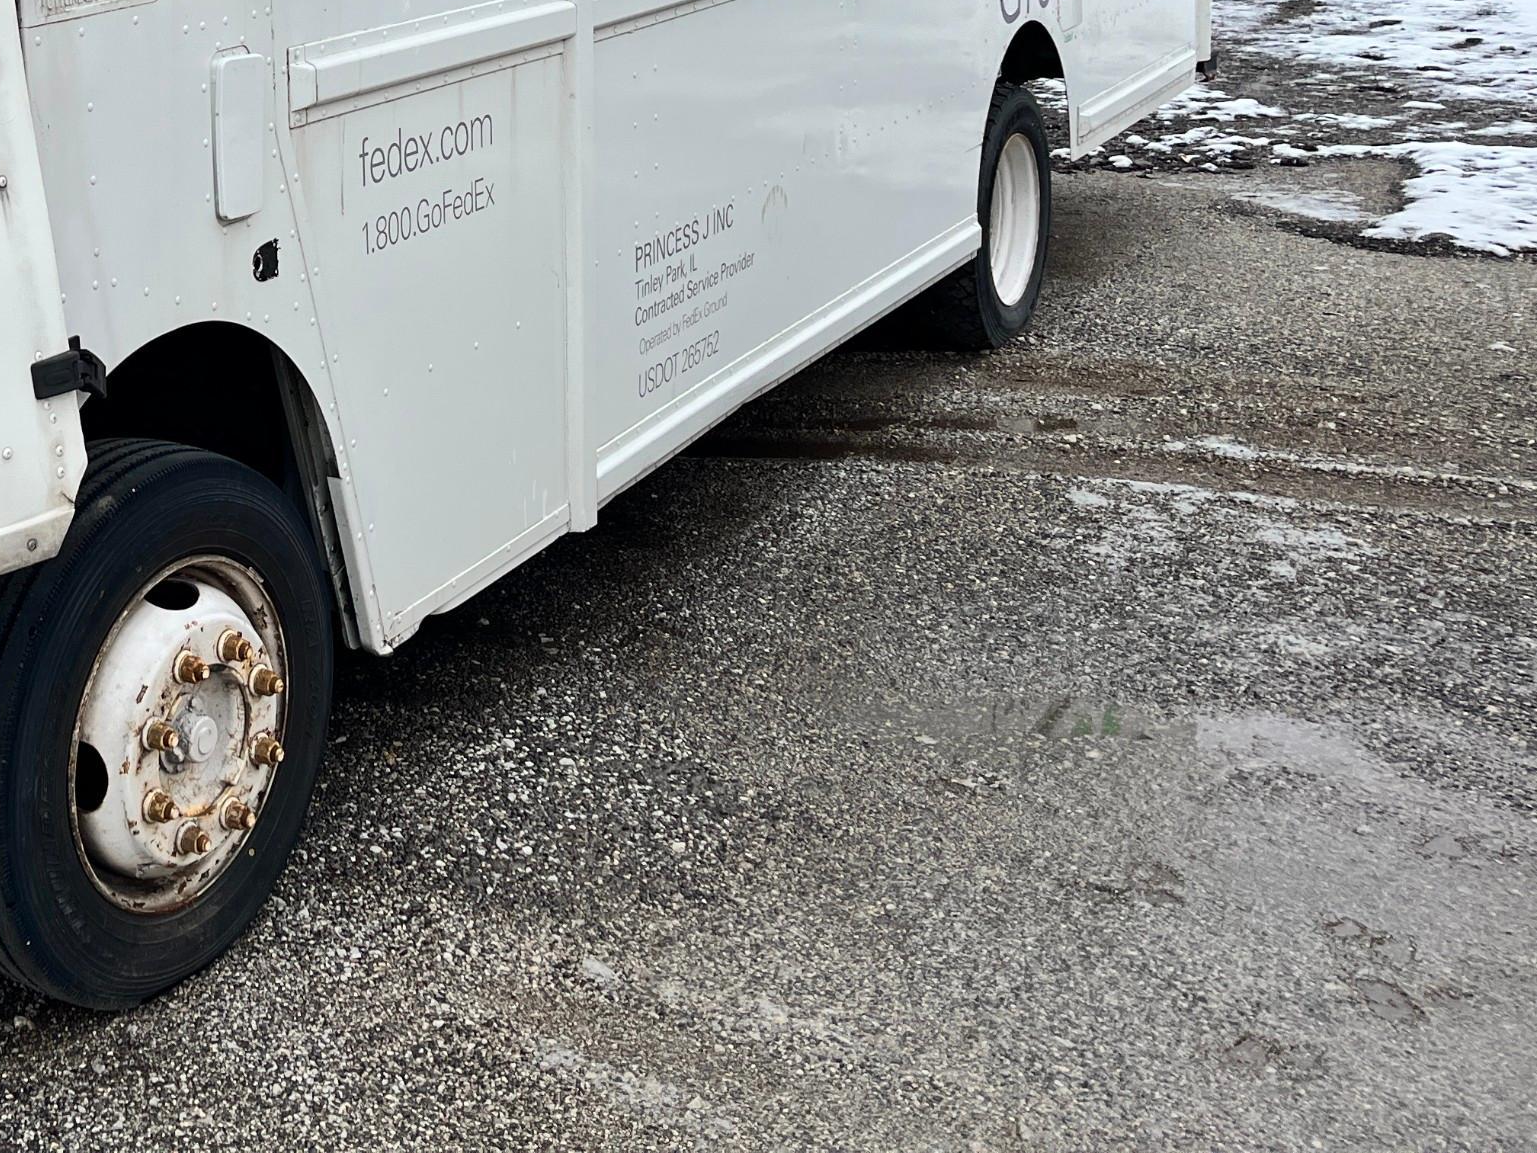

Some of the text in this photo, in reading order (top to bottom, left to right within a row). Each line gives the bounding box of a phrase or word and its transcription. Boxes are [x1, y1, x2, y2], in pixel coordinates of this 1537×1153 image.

[359, 114, 493, 187] fedex.com
[362, 177, 495, 255] 1.800.GoFedEx
[635, 203, 734, 273] PRINCESS J INC
[635, 253, 698, 301] Tinley Park, IL
[635, 251, 756, 327] Contracted Service Provider
[639, 292, 728, 356] Operated by FedEx Ground
[638, 330, 720, 398] USDOT 265752
